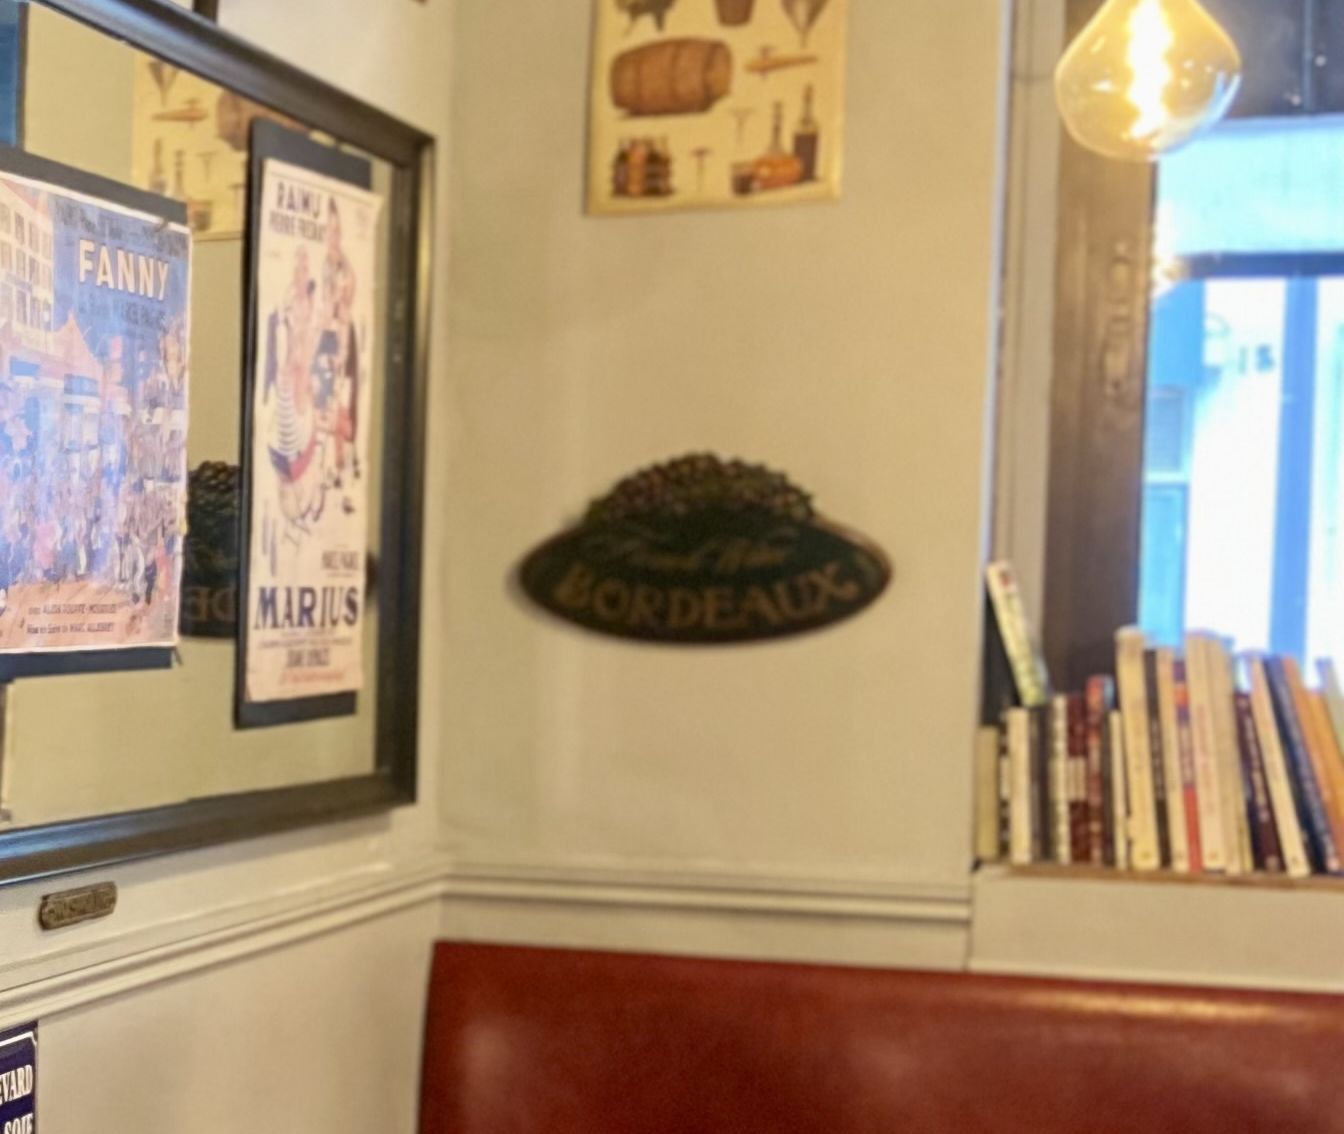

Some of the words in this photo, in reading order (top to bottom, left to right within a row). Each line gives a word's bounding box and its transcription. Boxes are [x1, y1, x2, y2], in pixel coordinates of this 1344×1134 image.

[79, 237, 170, 301] FANNY
[254, 585, 359, 631] MARIUS
[551, 560, 861, 631] BORDEAUX
